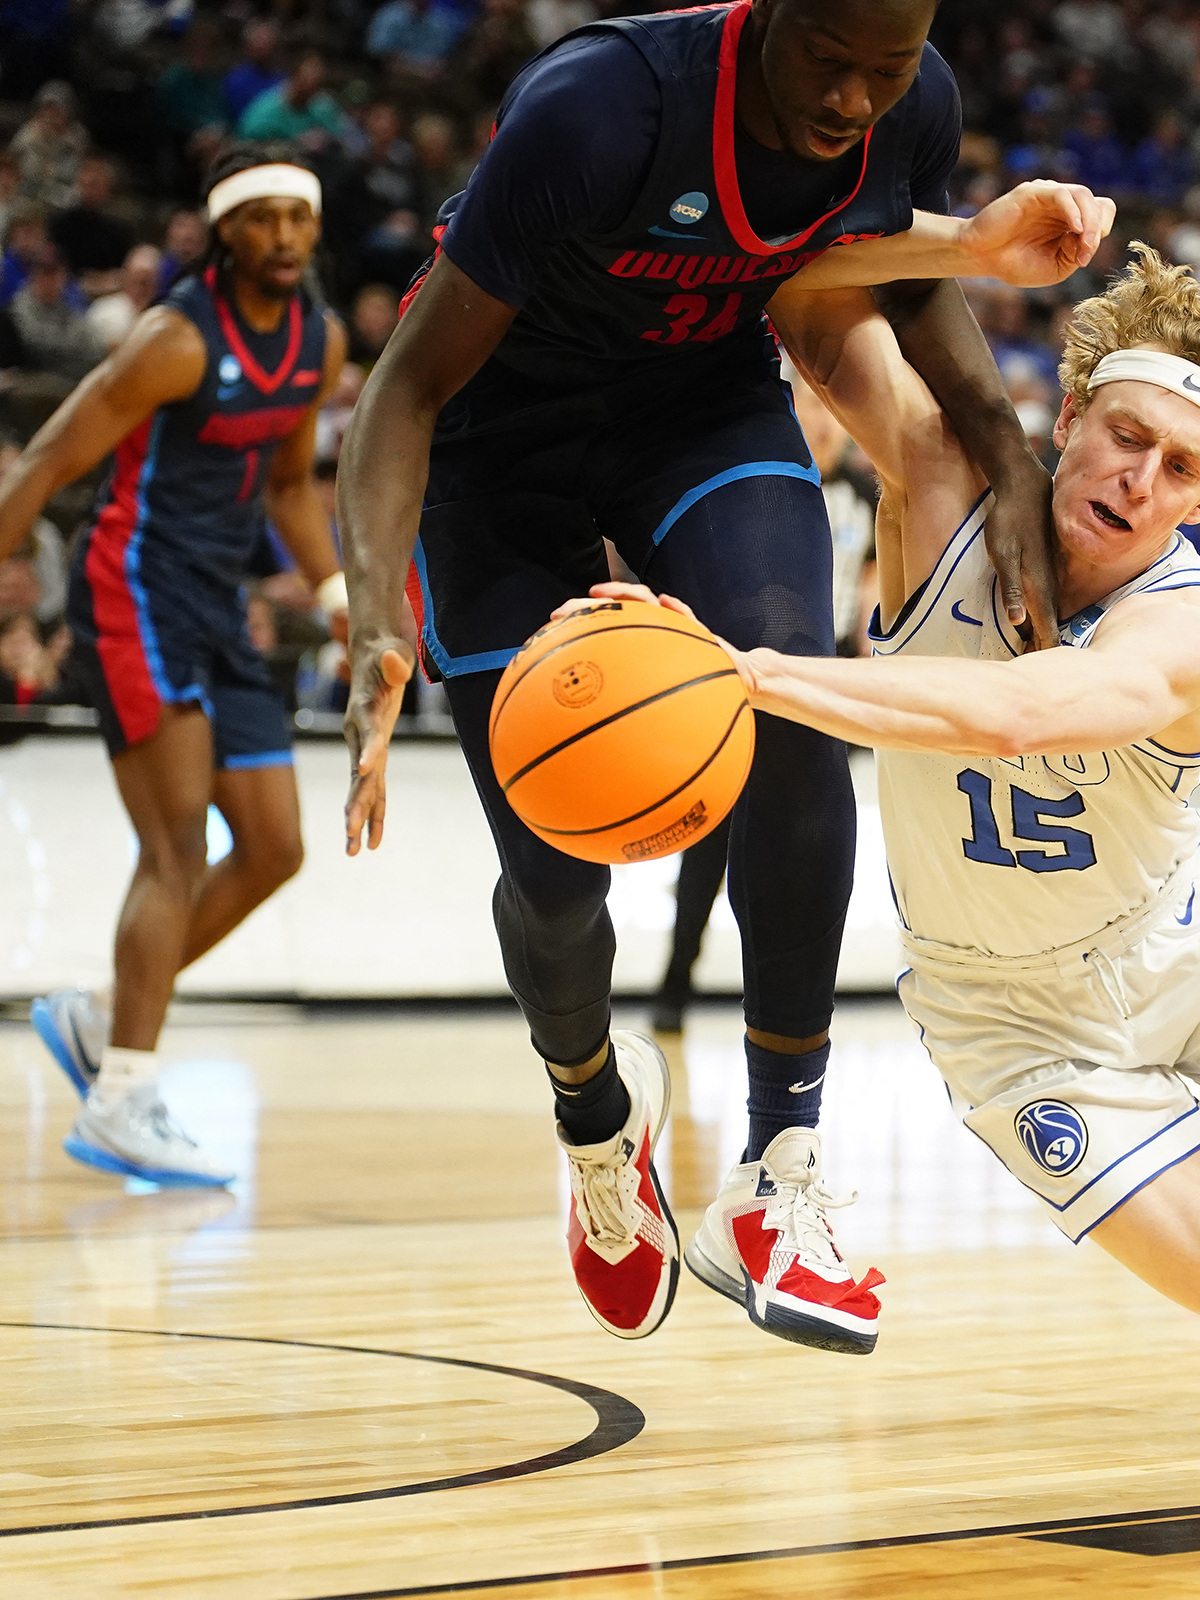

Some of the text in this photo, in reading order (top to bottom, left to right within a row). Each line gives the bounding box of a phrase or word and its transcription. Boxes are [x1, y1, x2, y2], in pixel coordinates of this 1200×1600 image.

[673, 203, 703, 220] NCAA
[639, 292, 743, 345] 34
[956, 767, 1098, 873] 15
